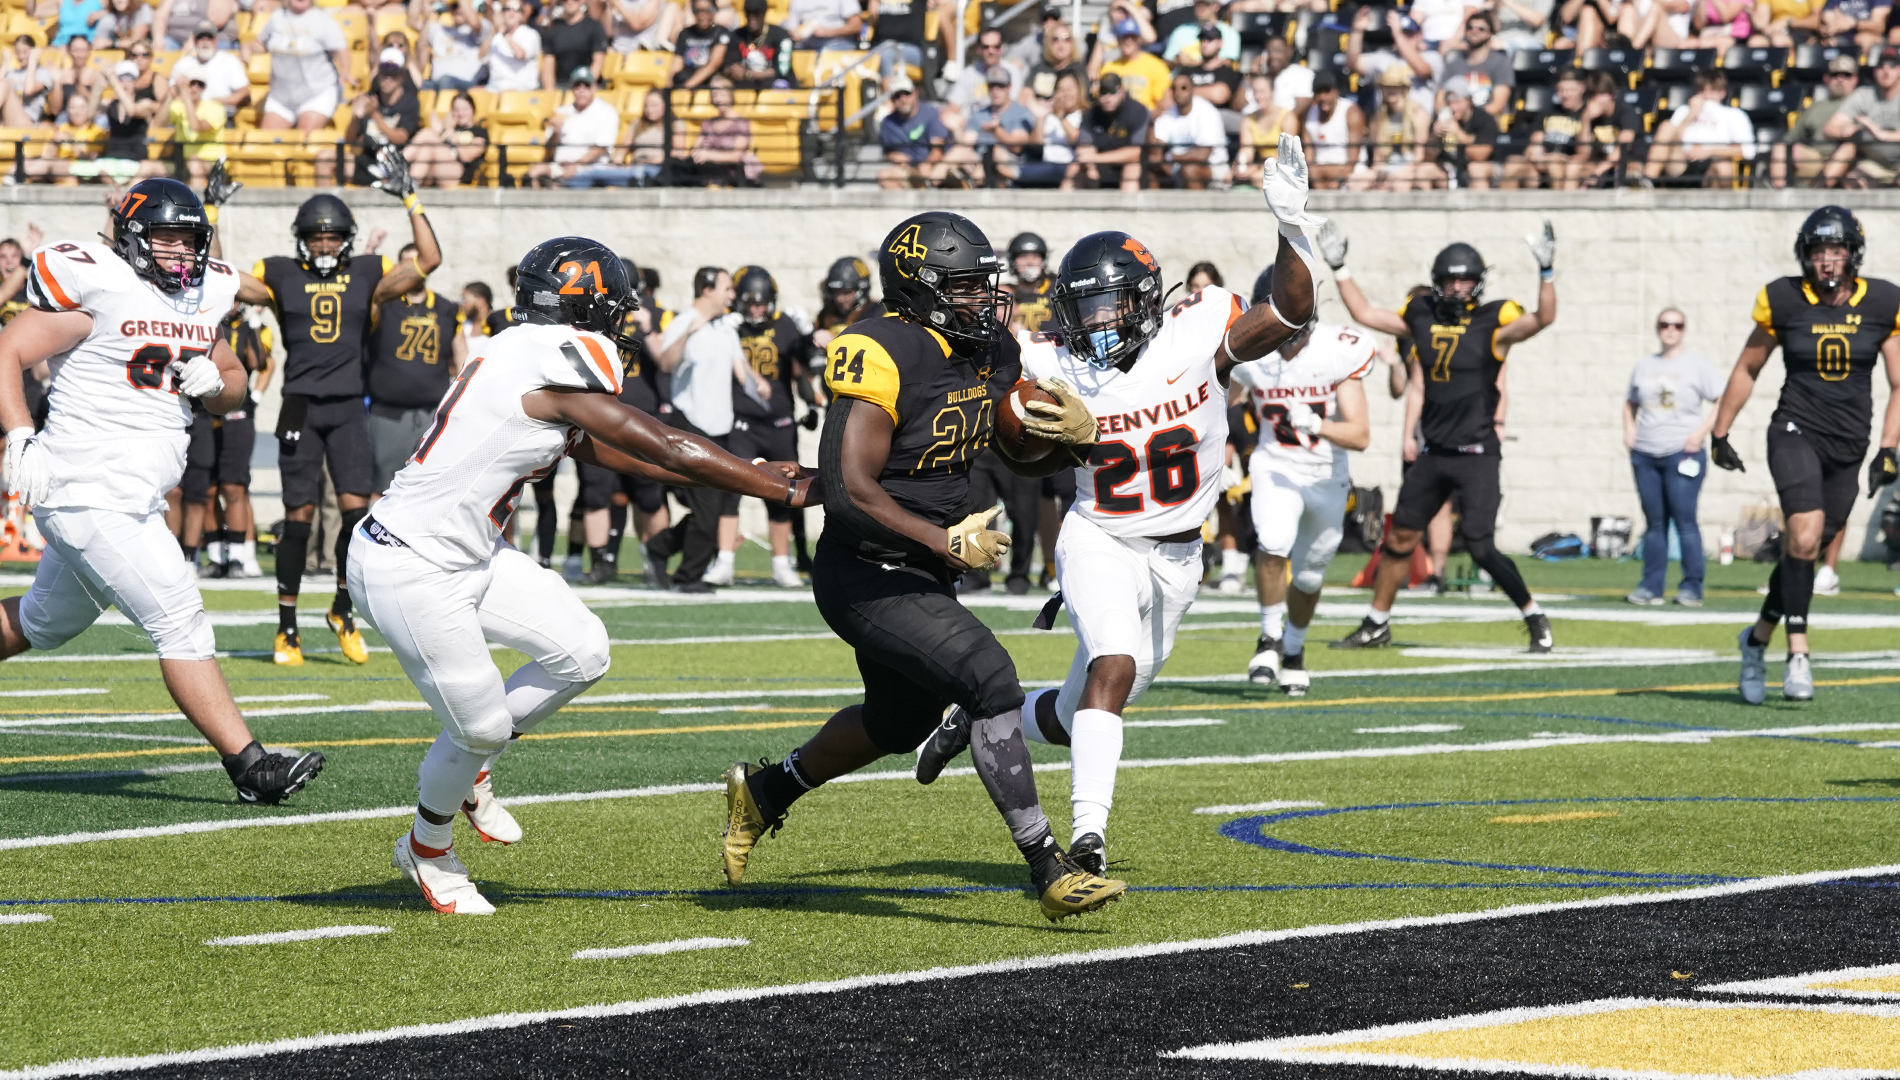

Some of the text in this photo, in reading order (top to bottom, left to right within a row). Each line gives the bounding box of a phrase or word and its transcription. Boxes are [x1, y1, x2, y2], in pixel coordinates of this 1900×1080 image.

[51, 243, 97, 265] 97
[558, 260, 608, 295] 21
[120, 319, 218, 344] GREENVILL
[310, 292, 342, 343] 9
[396, 319, 441, 365] 74
[1431, 333, 1460, 382] 7
[1816, 333, 1850, 381] 0
[832, 346, 867, 384] 24
[947, 385, 987, 405] BULLDOGS
[1097, 380, 1209, 435] EENVILLE
[1088, 423, 1201, 516] 26
[729, 799, 744, 838] adidas
